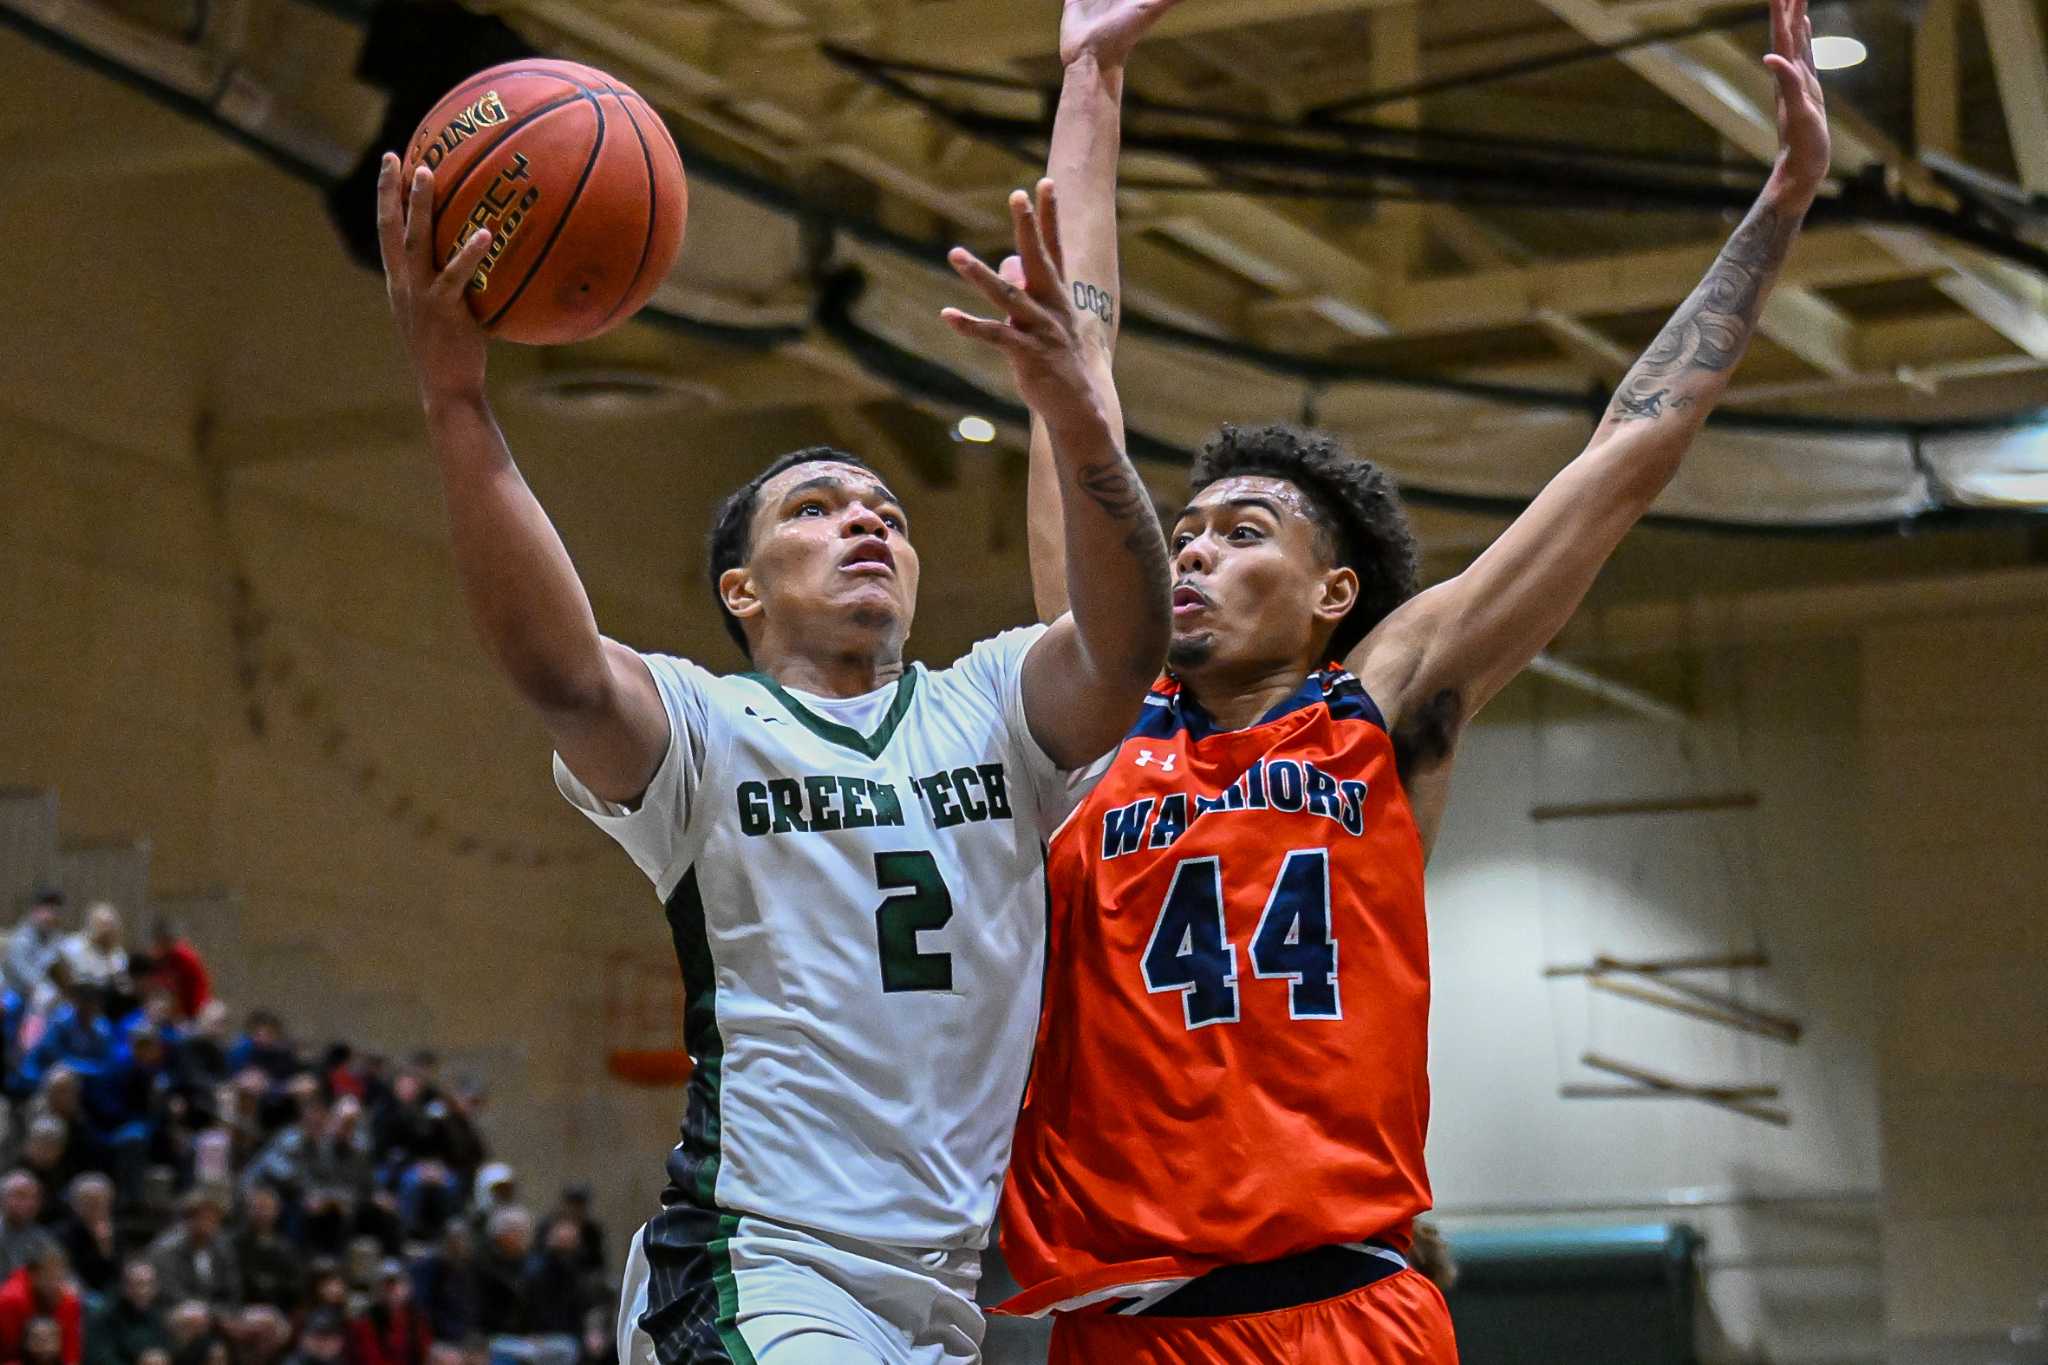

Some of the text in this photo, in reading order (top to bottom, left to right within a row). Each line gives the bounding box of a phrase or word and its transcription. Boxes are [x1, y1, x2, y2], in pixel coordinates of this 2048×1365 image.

[736, 775, 905, 837] GREEN
[873, 849, 954, 994] 2
[1139, 847, 1344, 1032] 44
